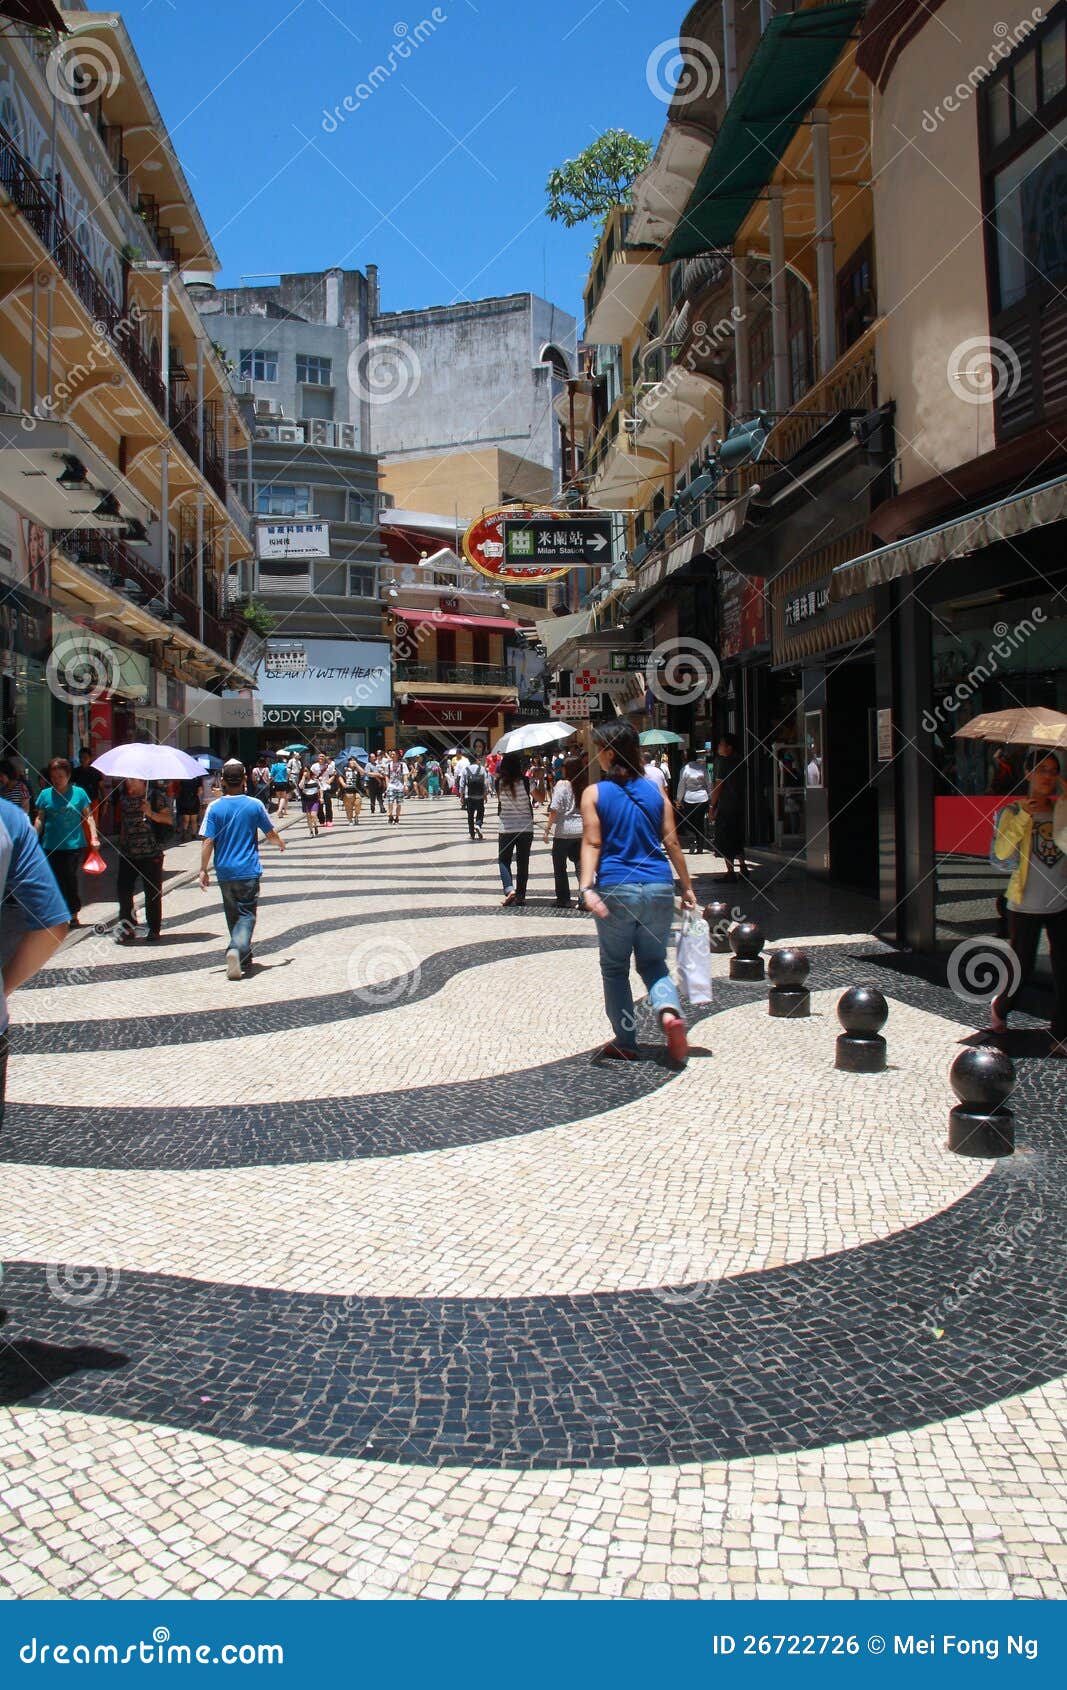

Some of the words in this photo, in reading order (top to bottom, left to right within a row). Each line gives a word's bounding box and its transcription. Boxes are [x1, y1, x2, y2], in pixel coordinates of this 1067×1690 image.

[538, 530, 583, 546] 米蘭站
[317, 668, 347, 679] WITH
[351, 667, 383, 679] HEART
[304, 710, 342, 723] SHOP
